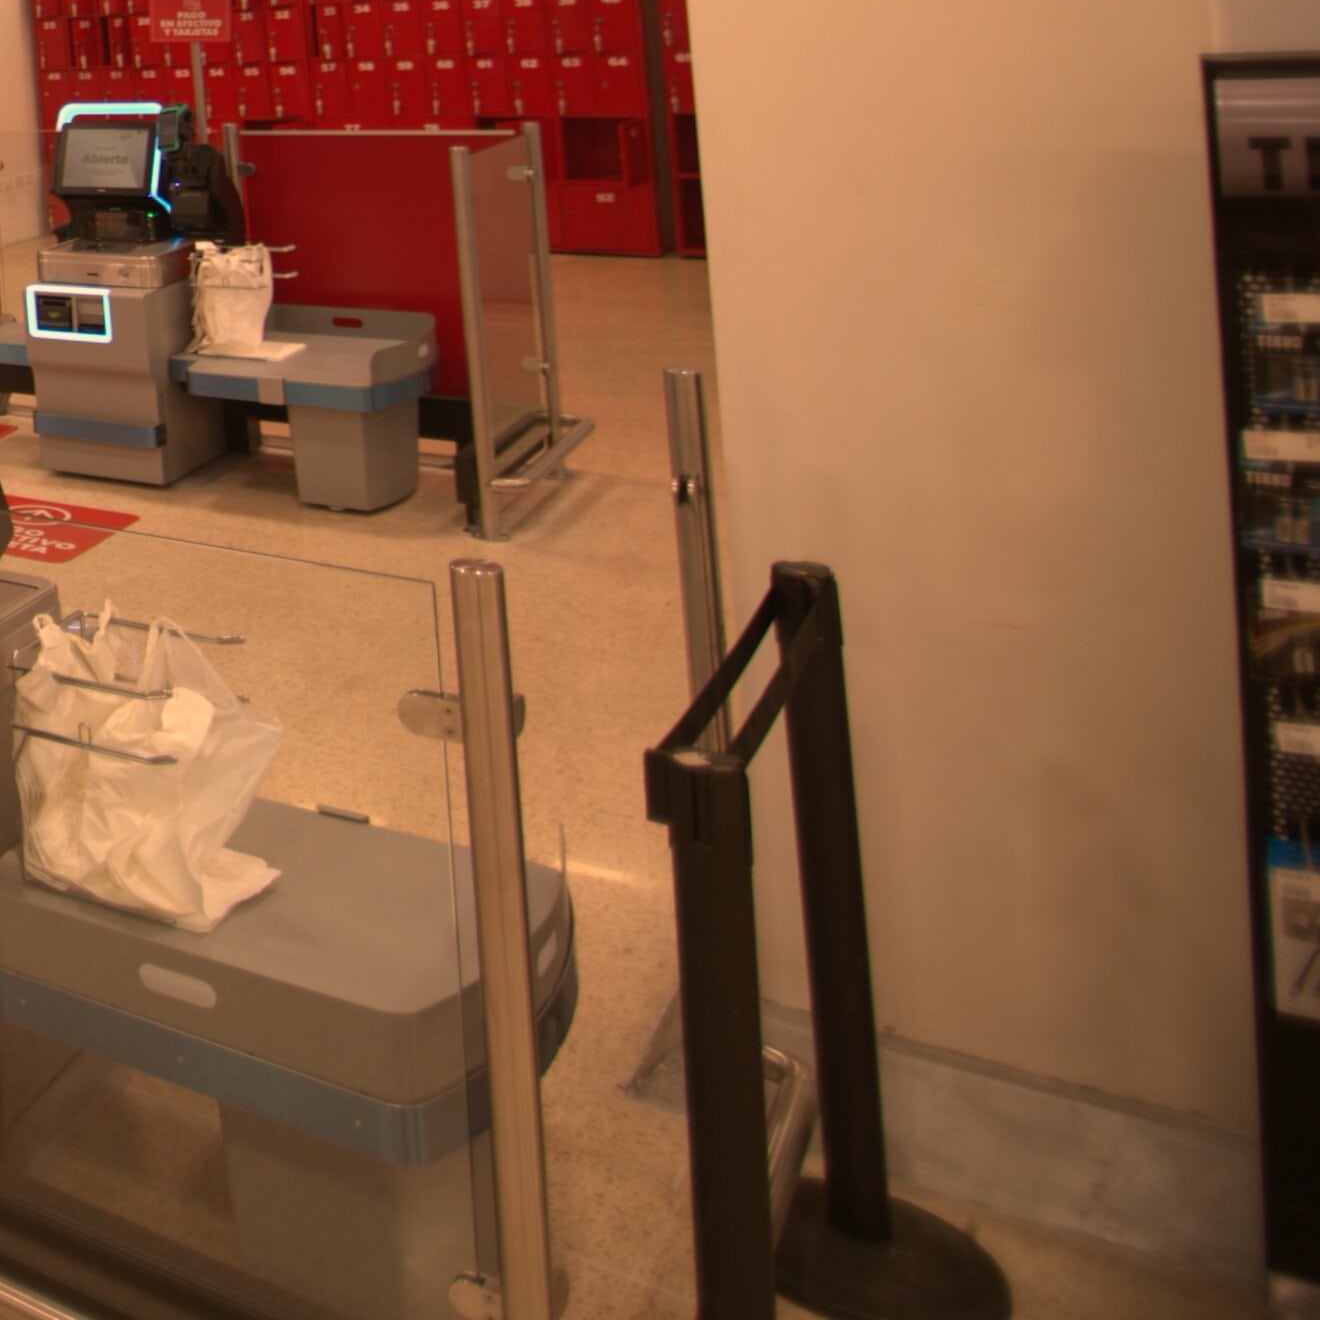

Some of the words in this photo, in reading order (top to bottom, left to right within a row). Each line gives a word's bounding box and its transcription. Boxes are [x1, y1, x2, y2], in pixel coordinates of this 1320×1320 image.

[354, 4, 371, 14] 34
[392, 2, 410, 12] 35
[432, 1, 450, 10] 36
[472, 0, 491, 9] 37
[176, 11, 206, 19] PAGO
[240, 12, 254, 22] 31
[274, 10, 290, 20] 32
[43, 20, 56, 30] 25
[160, 20, 175, 28] EN
[176, 19, 222, 28] EFECTIVO
[172, 27, 219, 36] TARJETAS
[520, 59, 538, 68] 62
[562, 58, 581, 68] 63
[608, 57, 629, 67] 64
[46, 72, 60, 80] 49
[78, 72, 92, 80] 50
[110, 70, 122, 80] 51
[142, 70, 156, 78] 52
[174, 68, 190, 78] 53
[208, 68, 224, 78] 54
[244, 66, 259, 76] 55
[278, 66, 296, 76] 56
[81, 153, 128, 165] Abierta
